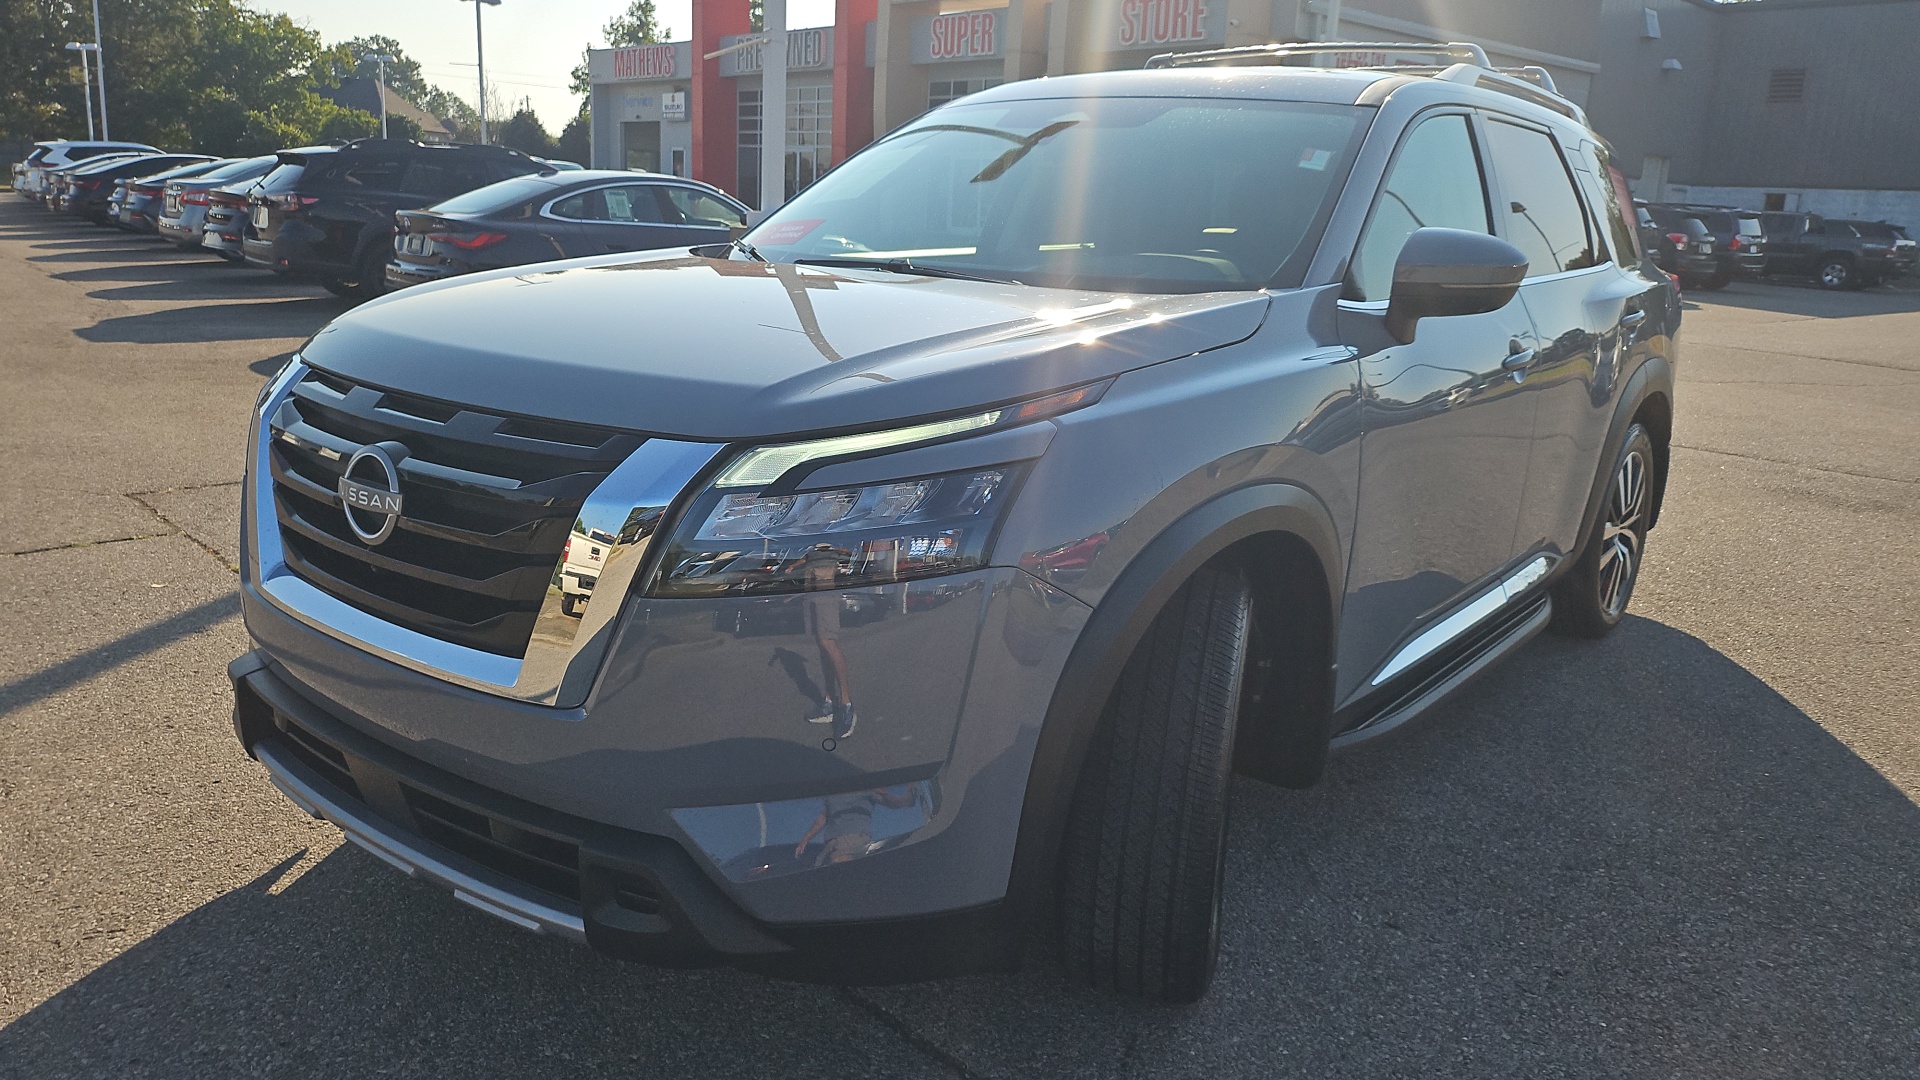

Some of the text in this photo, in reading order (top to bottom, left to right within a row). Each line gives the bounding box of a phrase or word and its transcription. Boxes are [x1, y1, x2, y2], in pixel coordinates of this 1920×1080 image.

[931, 12, 995, 58] SUPER
[1120, 0, 1206, 44] STORE
[614, 45, 674, 78] MATHEWS
